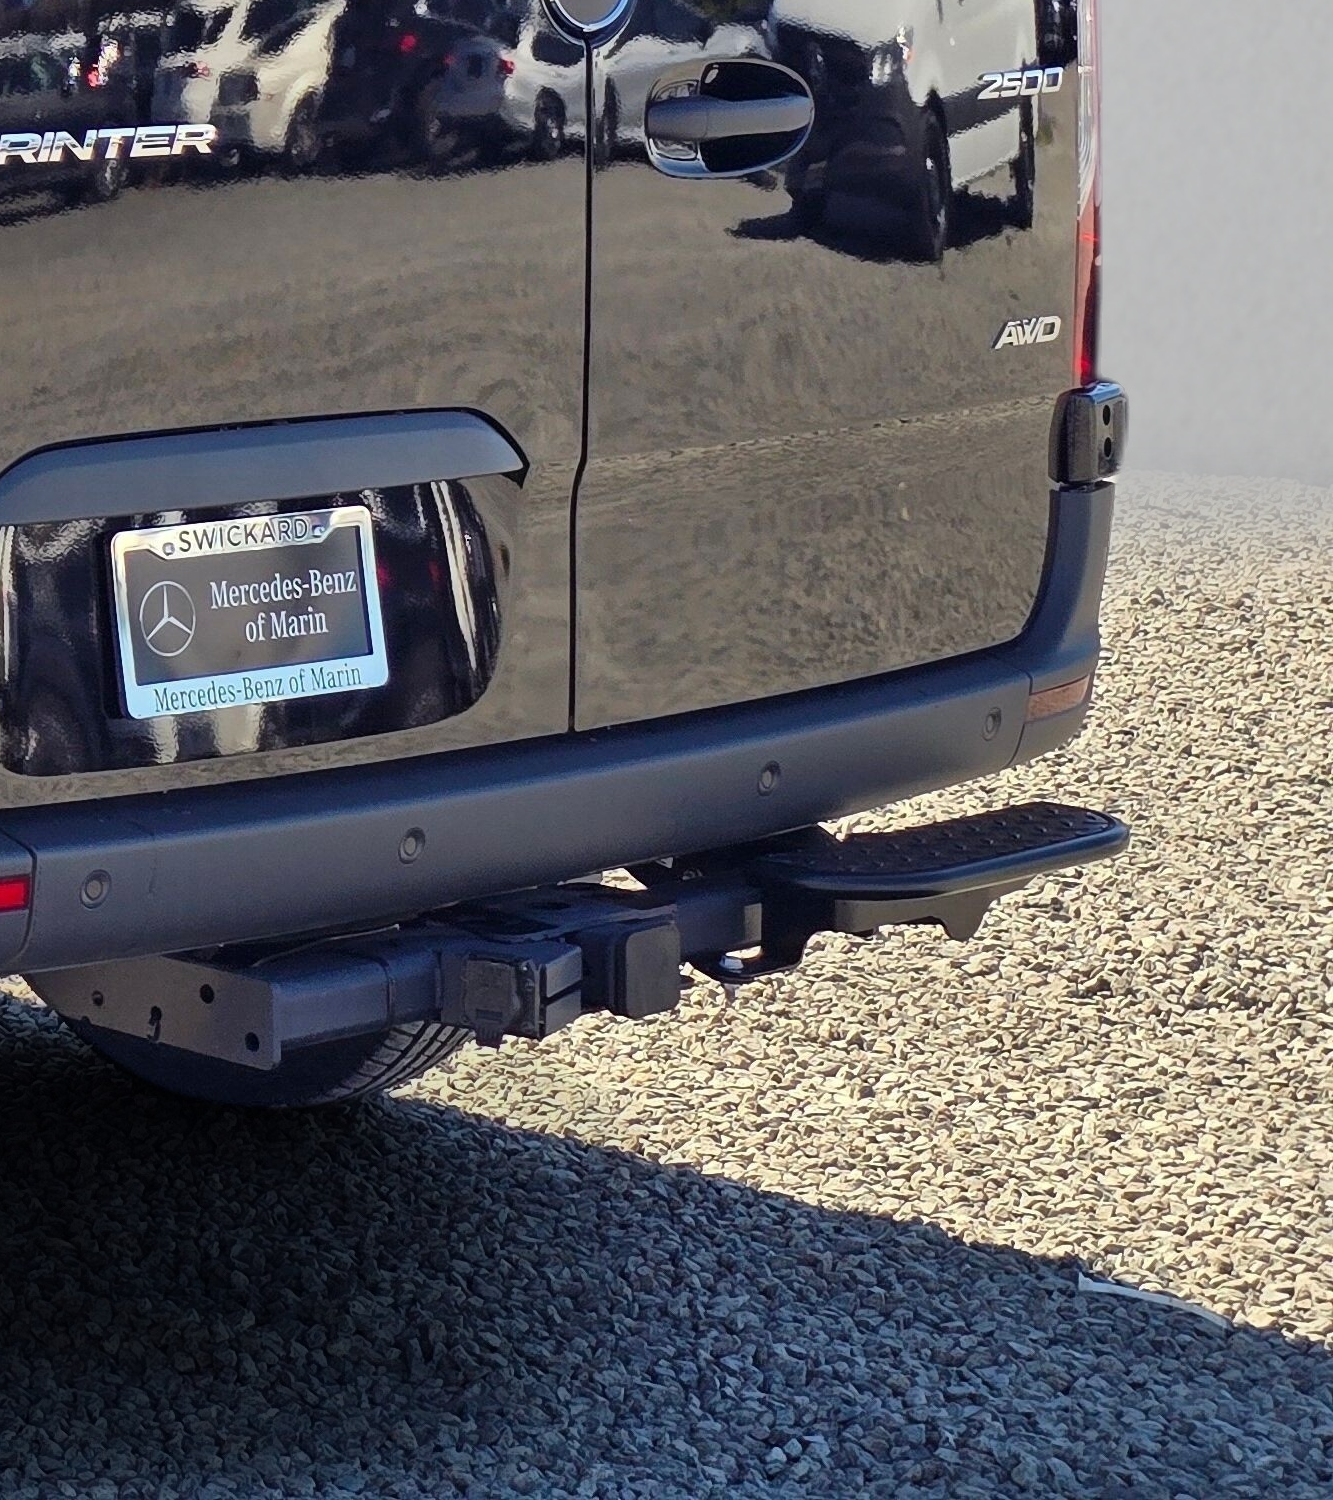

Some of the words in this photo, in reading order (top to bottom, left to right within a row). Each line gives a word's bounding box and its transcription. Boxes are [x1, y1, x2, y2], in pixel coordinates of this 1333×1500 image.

[976, 66, 1064, 101] 2500
[994, 315, 1062, 350] AWD
[178, 518, 309, 552] SWICKARD
[209, 569, 357, 610] Mercedes-Benz
[245, 612, 266, 643] of
[270, 606, 329, 639] Marin
[154, 675, 284, 712] Mercedes-Benz
[289, 669, 307, 694] of
[311, 663, 362, 688] Marin
